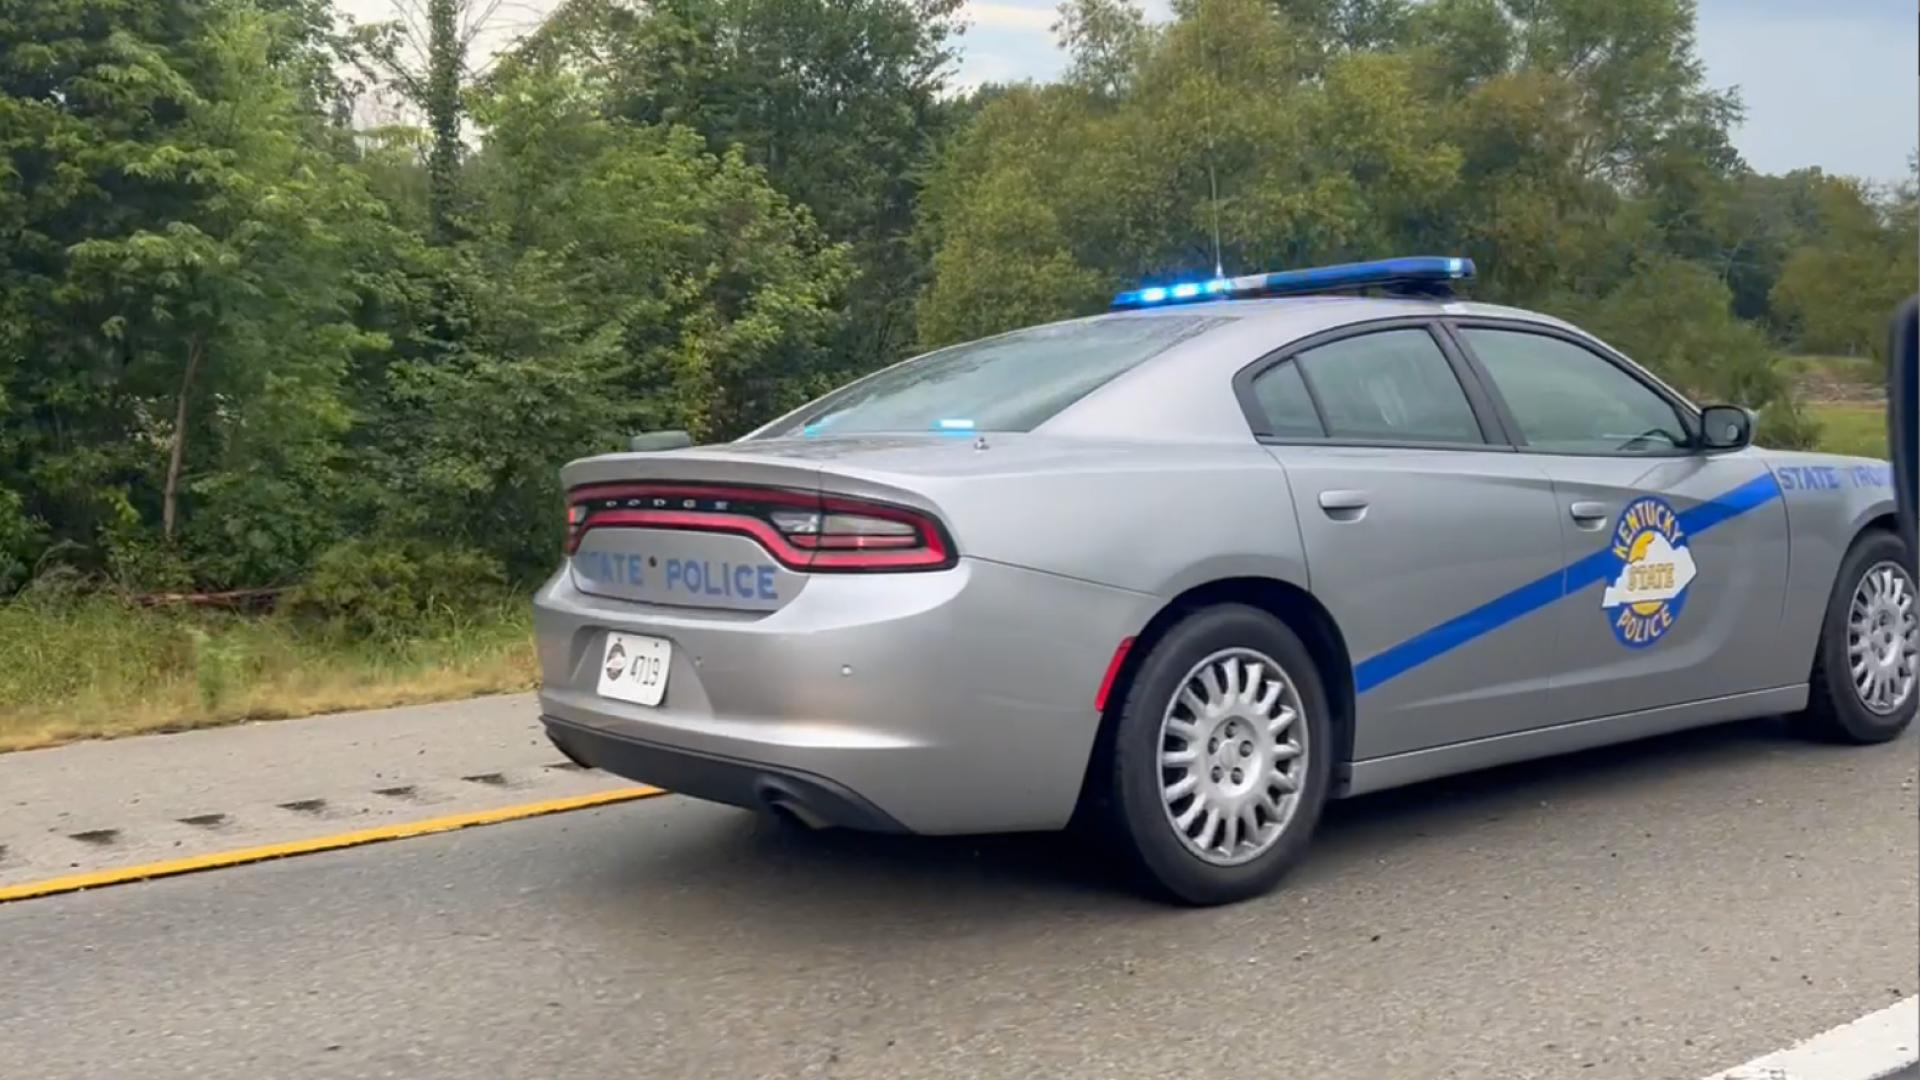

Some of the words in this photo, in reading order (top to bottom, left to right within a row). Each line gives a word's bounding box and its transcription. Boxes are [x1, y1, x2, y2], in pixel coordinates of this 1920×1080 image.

[1777, 466, 1840, 490] STATE
[1613, 501, 1684, 559] KENTUCKY
[665, 558, 779, 600] POLICE
[1628, 563, 1675, 592] STATE
[1616, 604, 1672, 642] POLICE
